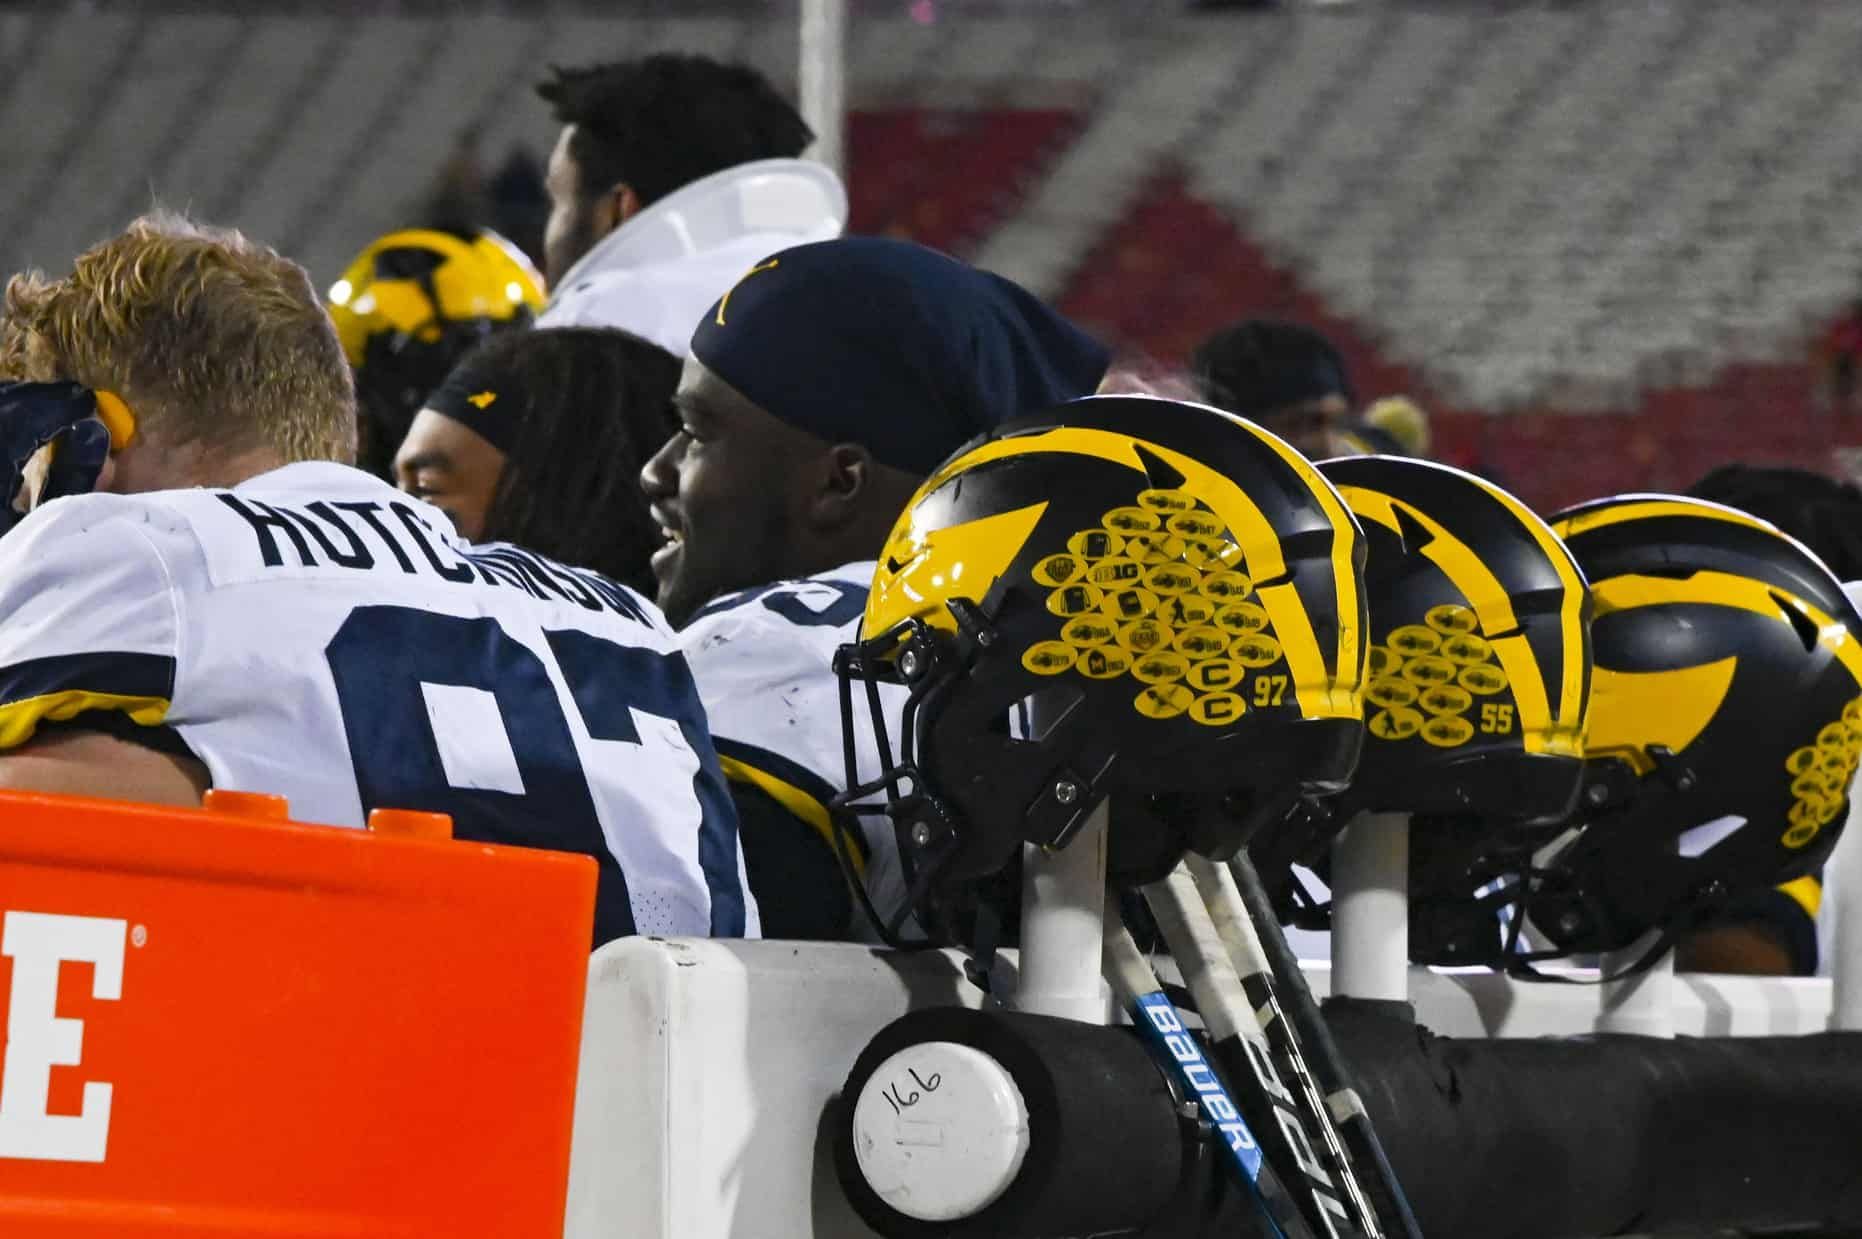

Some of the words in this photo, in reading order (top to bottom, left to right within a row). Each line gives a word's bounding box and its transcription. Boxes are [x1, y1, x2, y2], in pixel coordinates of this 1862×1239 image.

[1252, 674, 1288, 708] 97
[1480, 703, 1513, 734] 55
[882, 1067, 941, 1116] 166
